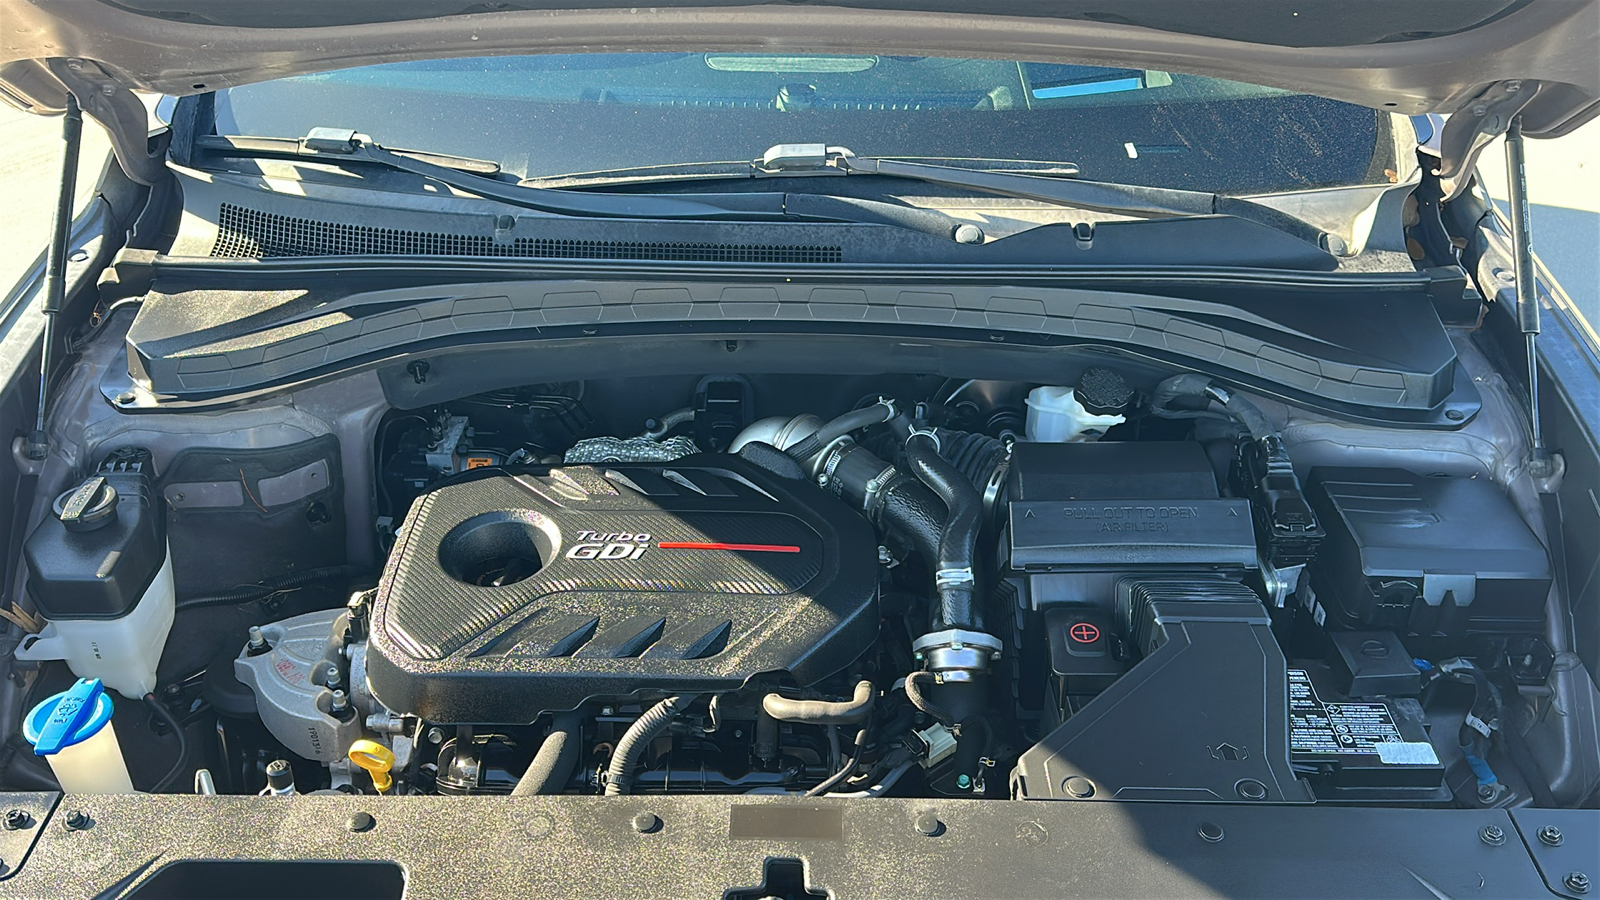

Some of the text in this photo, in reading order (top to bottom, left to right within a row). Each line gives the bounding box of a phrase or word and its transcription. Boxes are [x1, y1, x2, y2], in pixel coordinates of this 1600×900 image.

[1063, 506, 1199, 519] PULL OUT TO OPEN
[576, 530, 653, 542] Turbo
[565, 543, 651, 561] GDi
